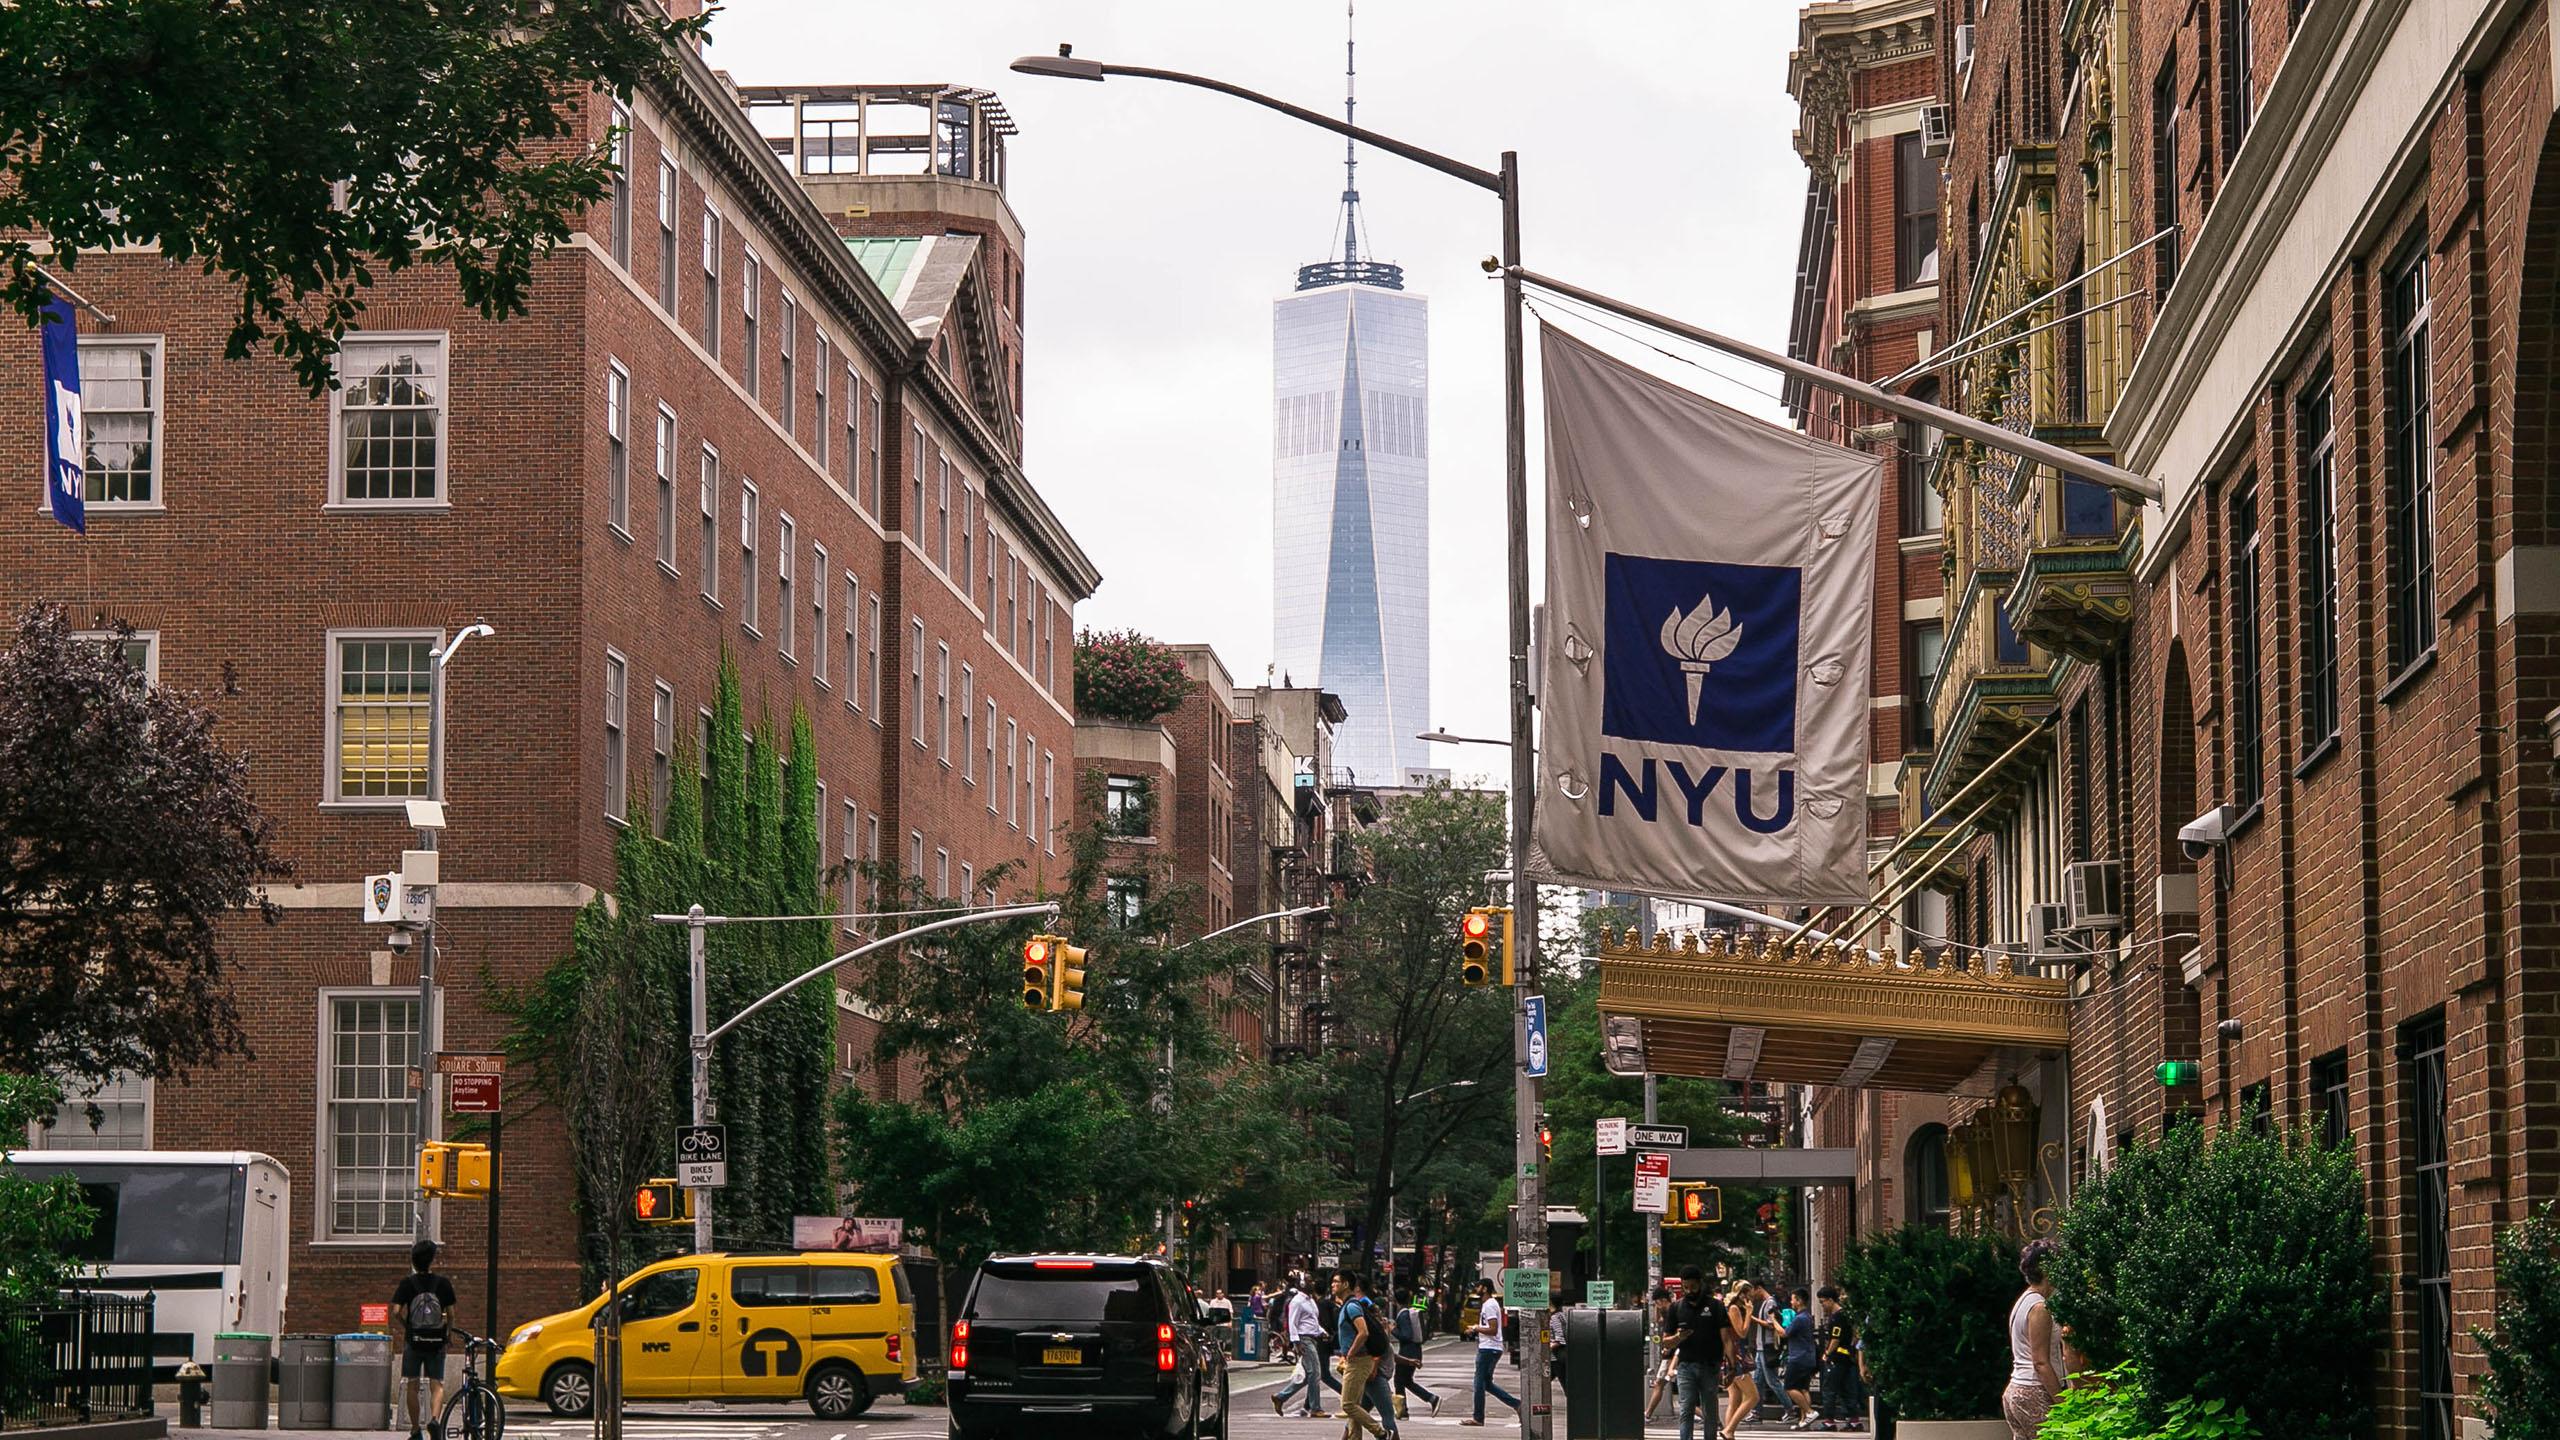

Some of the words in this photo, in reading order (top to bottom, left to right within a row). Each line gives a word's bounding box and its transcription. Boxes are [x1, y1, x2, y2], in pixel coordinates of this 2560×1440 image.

[1597, 752, 1795, 834] NYU
[440, 1060, 471, 1072] SQUARE
[475, 1060, 501, 1072] SOUTH
[463, 1078, 492, 1086] STOPPING
[454, 1087, 479, 1095] Anytime
[1634, 1131, 1654, 1141] ONE
[1659, 1132, 1680, 1143] WAY
[680, 1153, 698, 1162] BIKE
[701, 1152, 722, 1161] LANE
[690, 1165, 713, 1175] BIKES
[691, 1175, 713, 1184] ONLY
[1513, 1281, 1542, 1289] PARKING
[1513, 1291, 1543, 1299] SUNDAY
[642, 1342, 672, 1353] NYC
